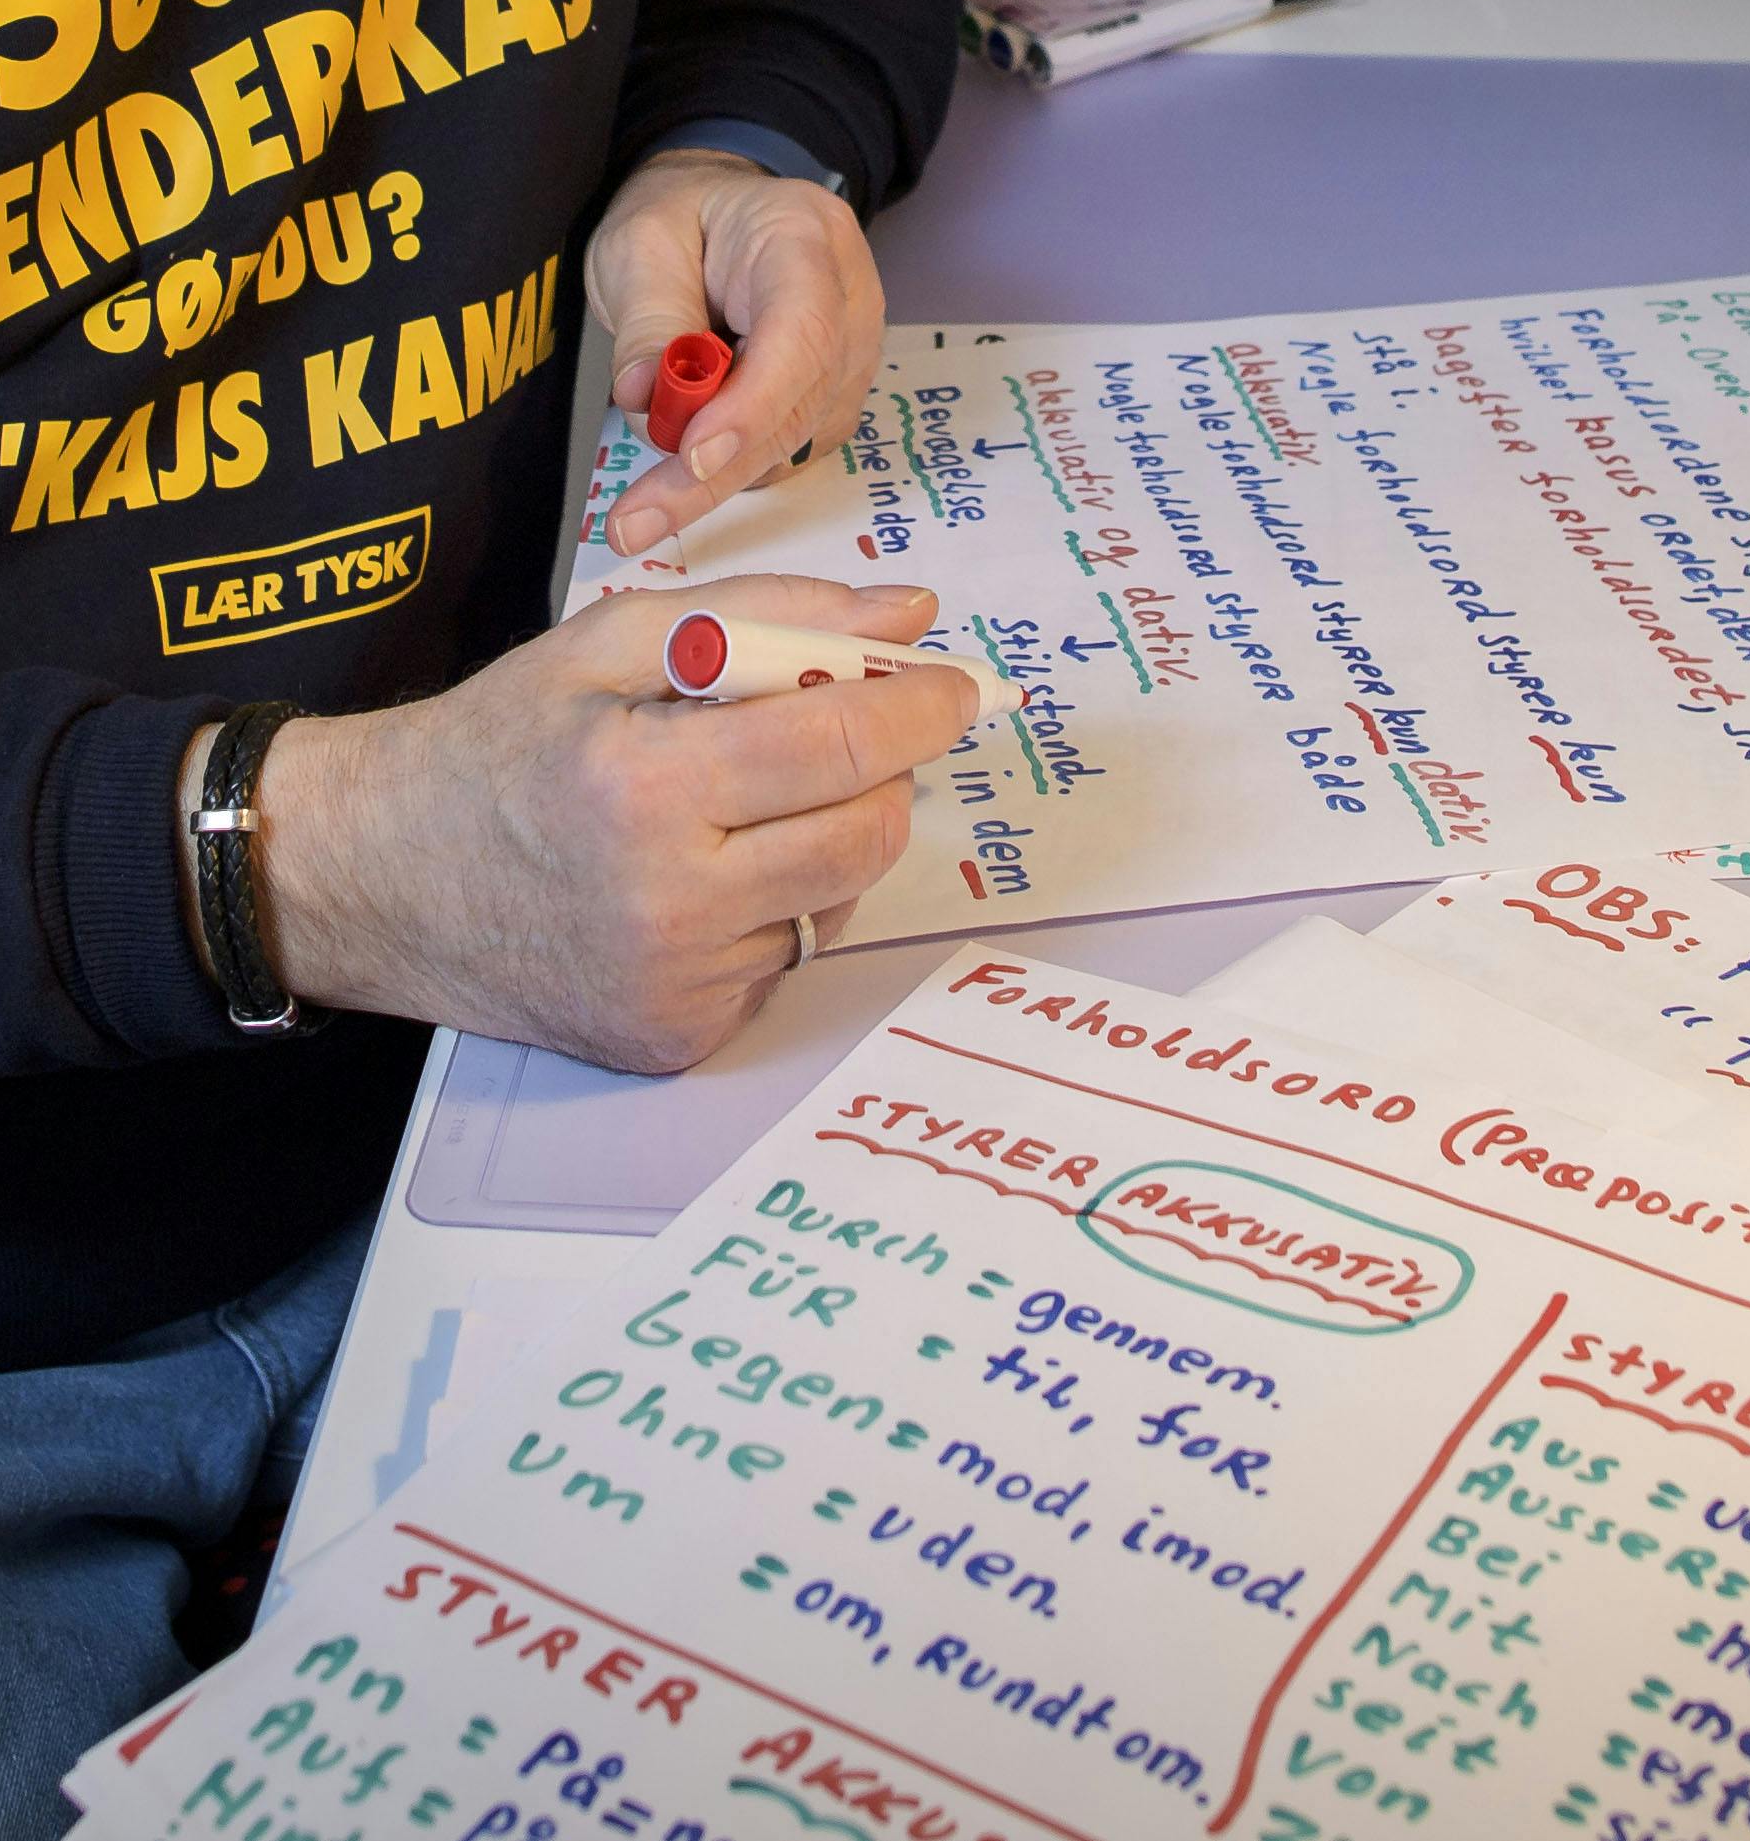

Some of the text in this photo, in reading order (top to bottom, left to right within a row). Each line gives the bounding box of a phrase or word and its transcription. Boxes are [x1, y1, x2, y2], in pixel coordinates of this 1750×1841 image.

[1094, 361, 1153, 426] Nogle
[183, 535, 414, 628] LÆR TYSK
[1166, 352, 1231, 434] Nogle
[1372, 704, 1430, 755] kun
[1287, 340, 1357, 415] Nogle
[1560, 739, 1628, 803] kun
[970, 818, 1035, 896] dem
[1535, 863, 1701, 953] OBS:
[838, 1093, 1099, 1188] STYRER
[558, 1369, 785, 1480] Ohne
[1488, 1416, 1621, 1485] Aus
[508, 1432, 644, 1523] Um
[1425, 1514, 1563, 1587] Bei
[384, 1564, 700, 1728] STYRER
[1387, 1571, 1542, 1656] Mit
[294, 1634, 405, 1715] An
[1351, 1623, 1540, 1730] Nach
